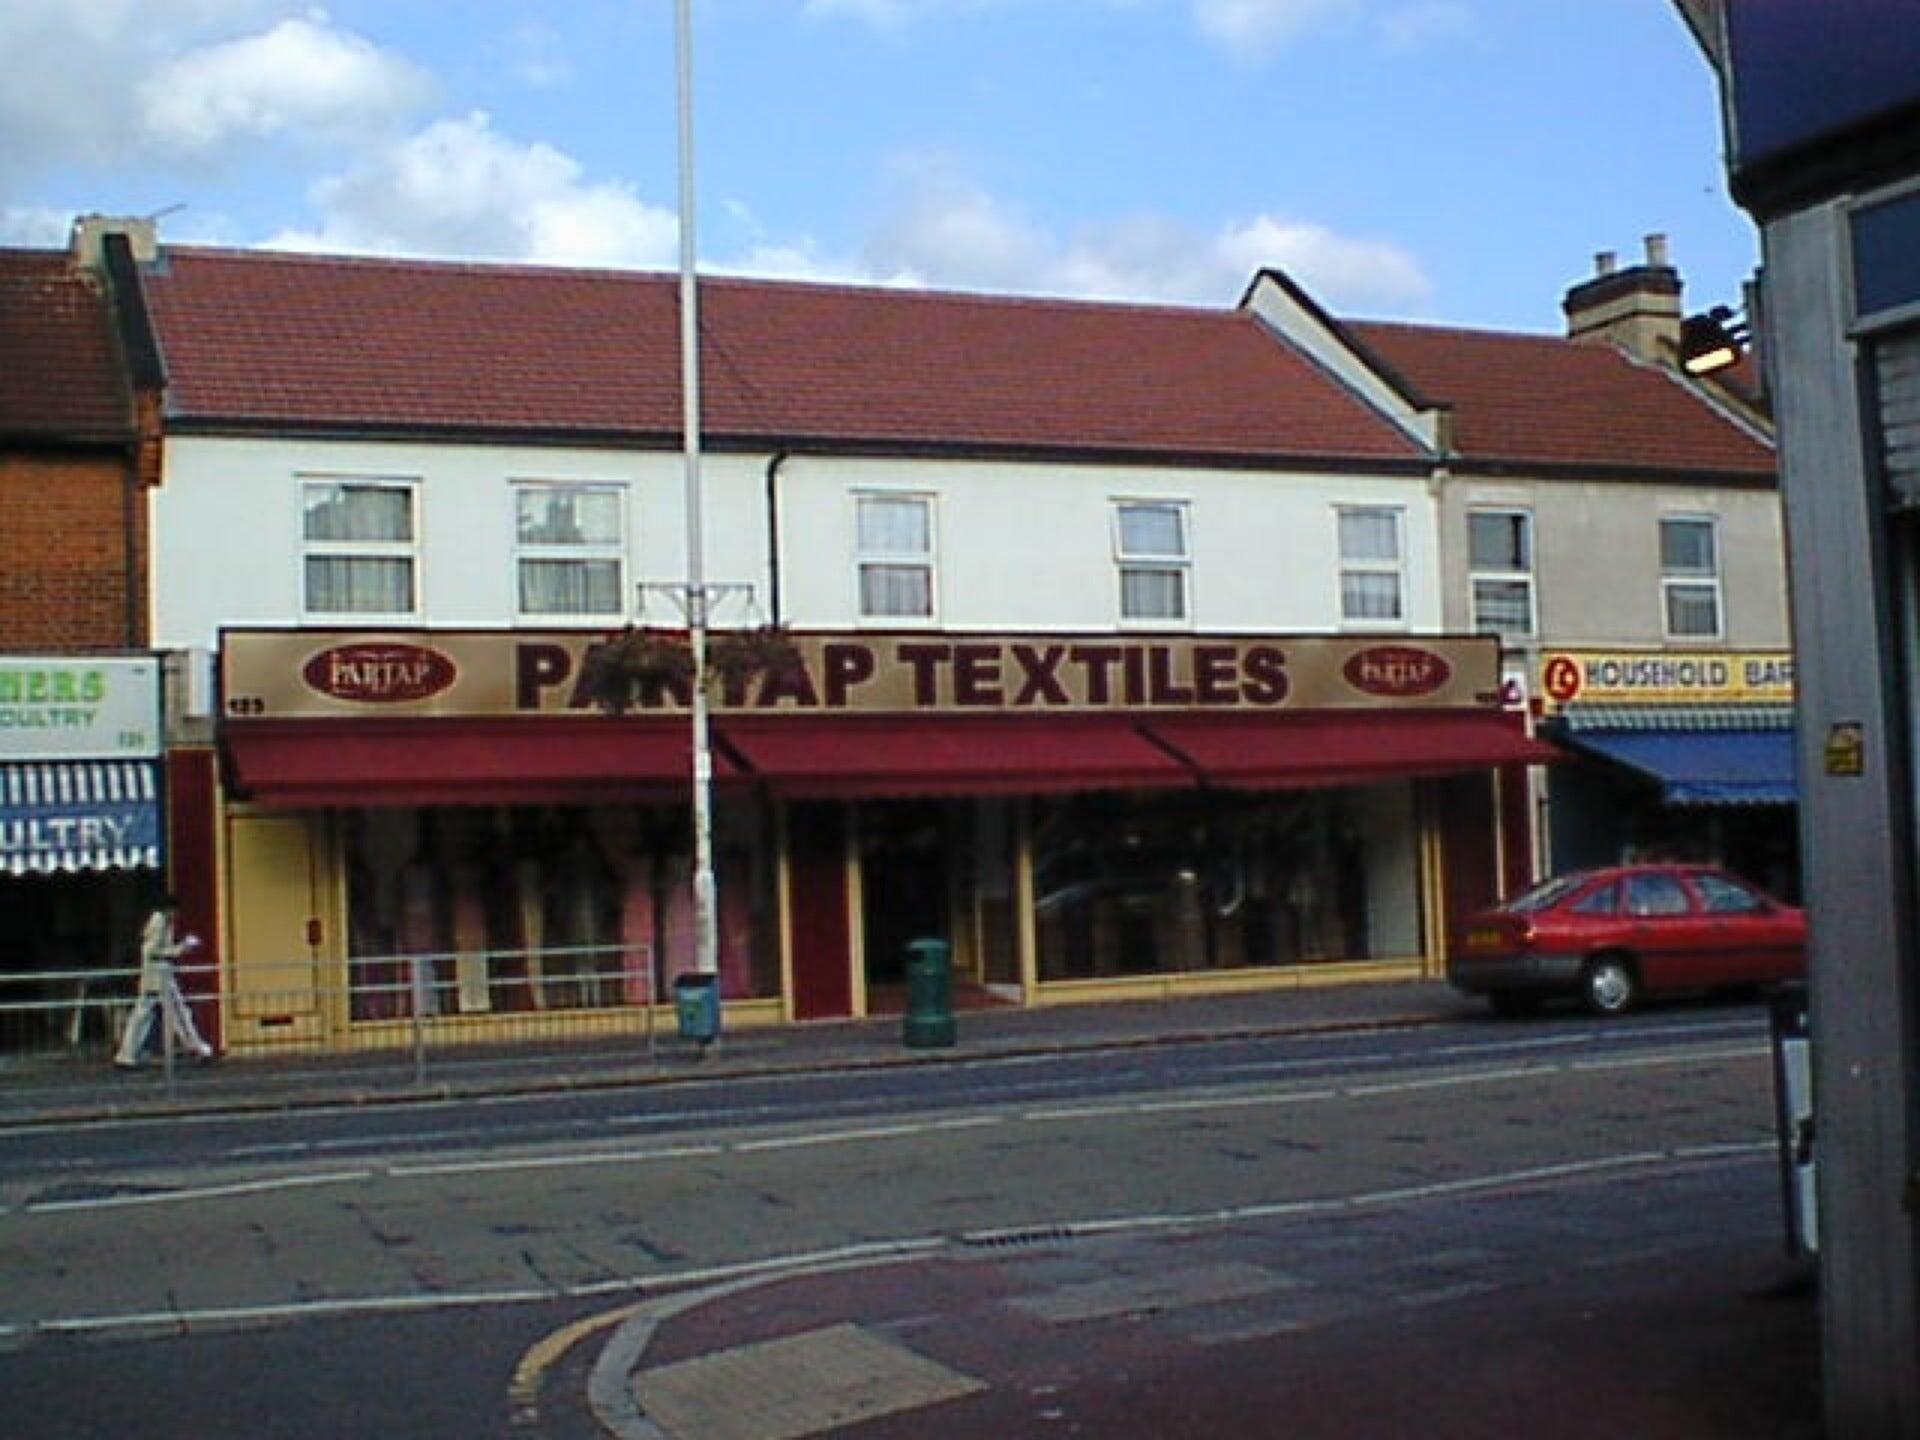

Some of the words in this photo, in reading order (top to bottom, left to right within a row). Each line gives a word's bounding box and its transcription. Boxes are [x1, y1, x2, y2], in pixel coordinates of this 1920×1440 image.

[896, 643, 1290, 706] TEXTILES
[1584, 659, 1726, 688] HOUSEHOLD
[0, 814, 134, 849] ULTRY
